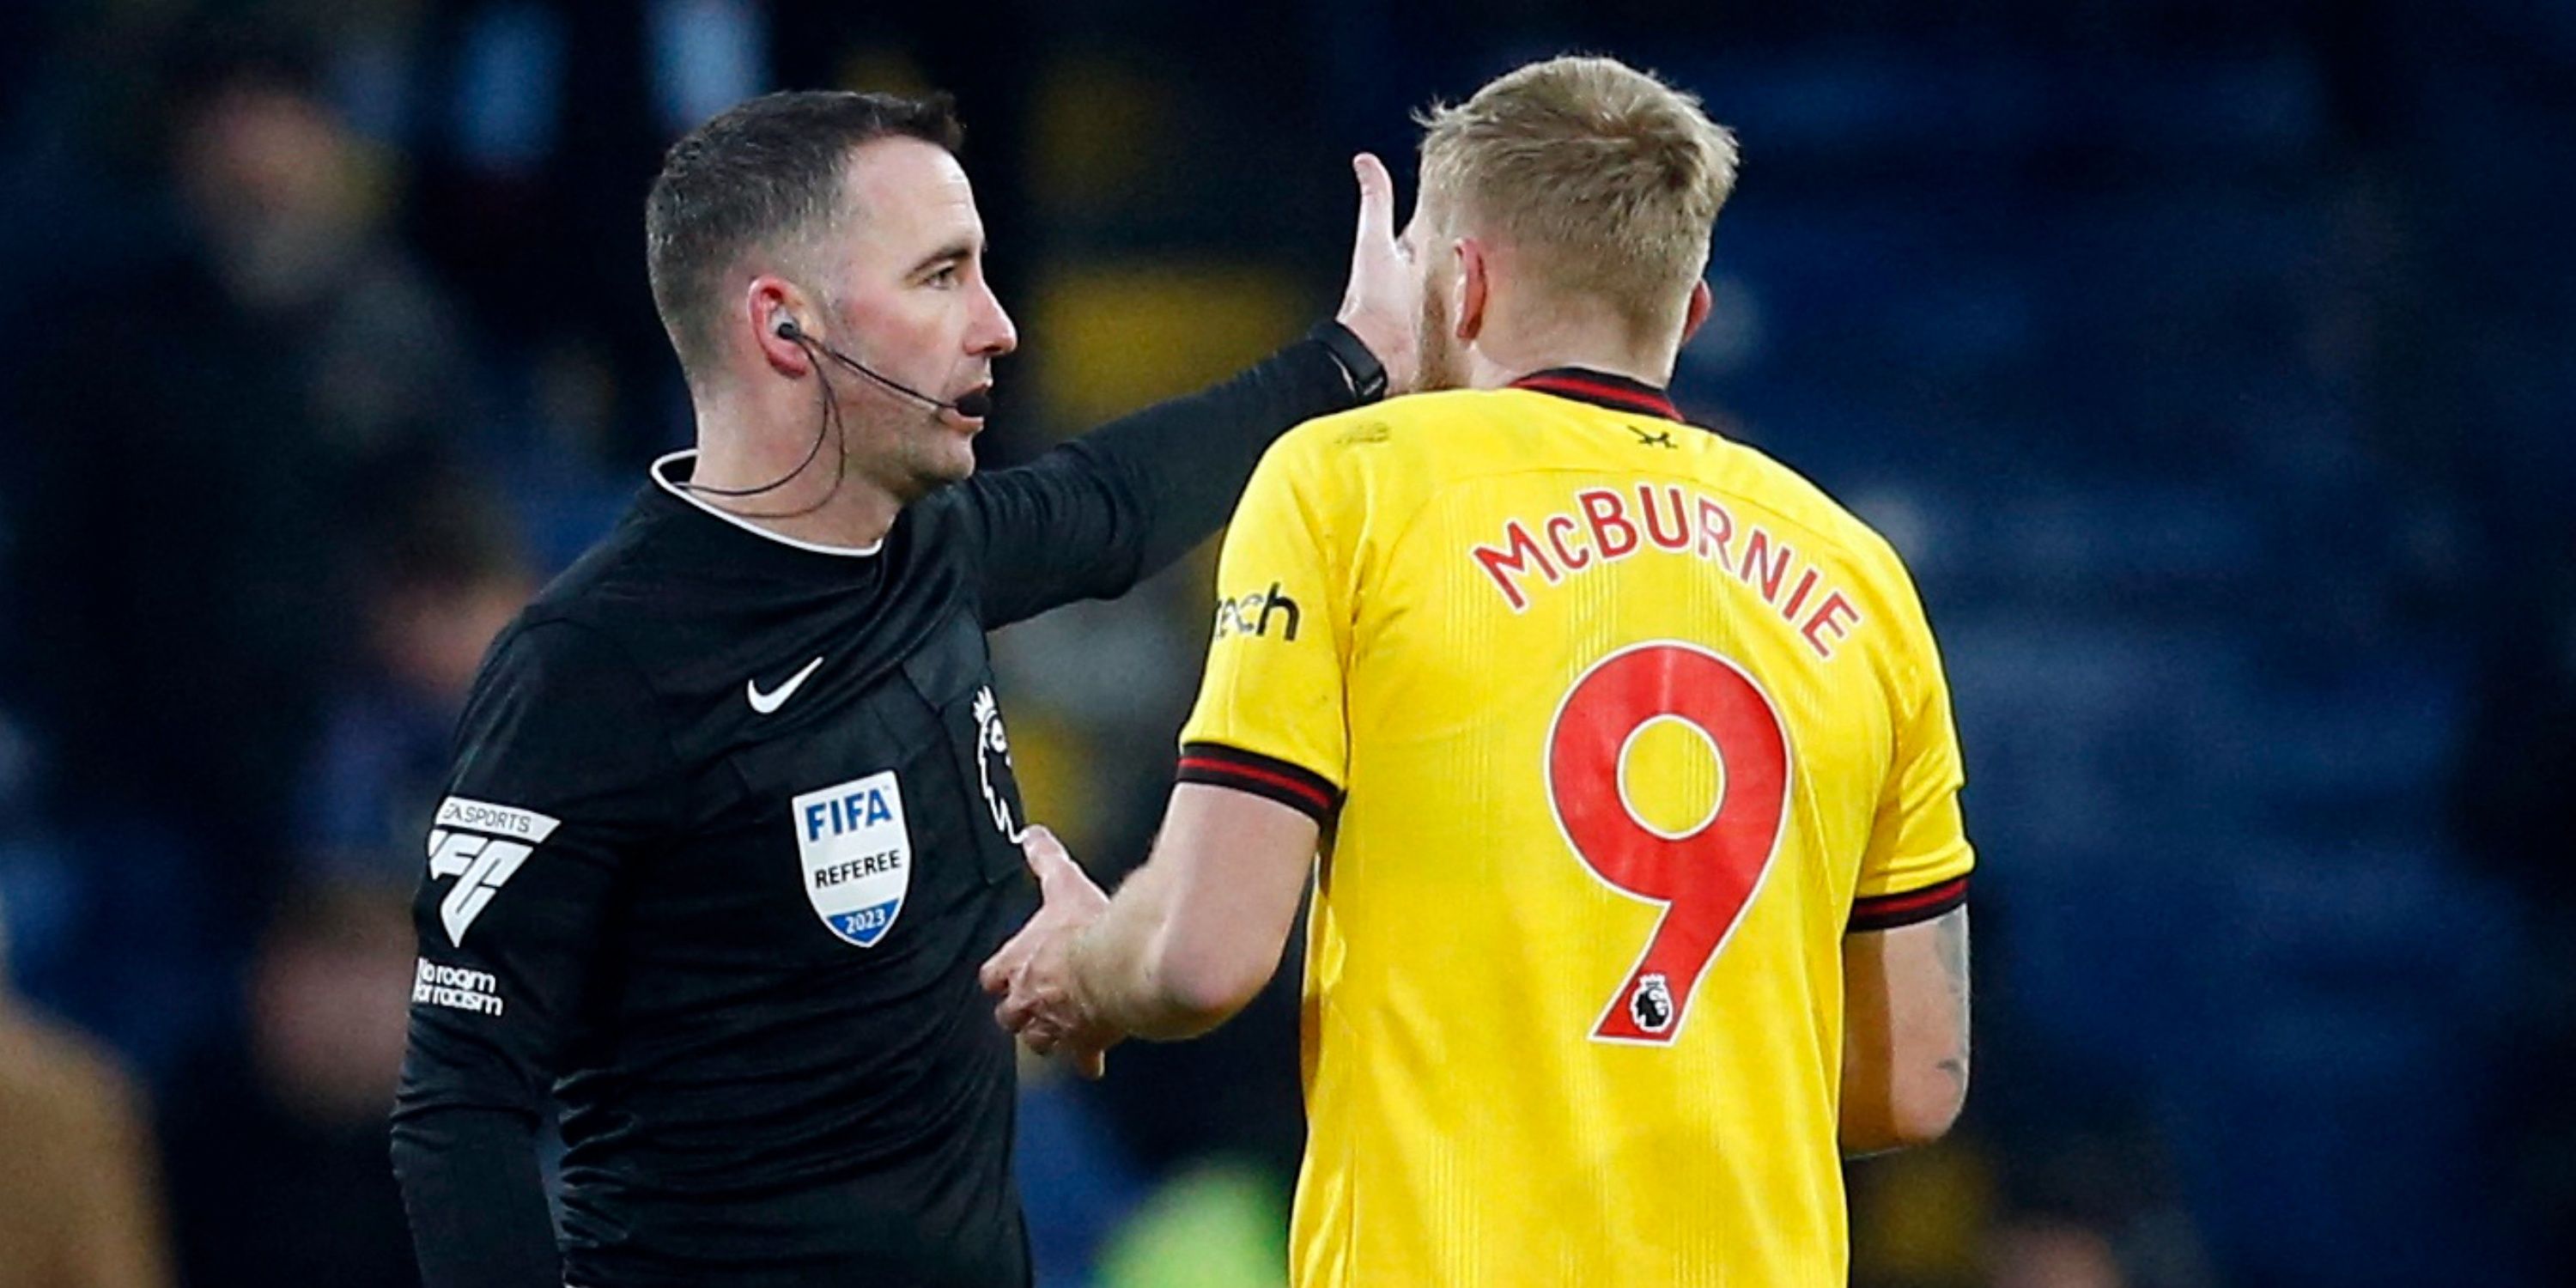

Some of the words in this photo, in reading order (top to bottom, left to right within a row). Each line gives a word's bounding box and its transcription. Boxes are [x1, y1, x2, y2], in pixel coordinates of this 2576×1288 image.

[1472, 483, 1862, 659] McBURNIE
[1213, 580, 1300, 642] ech
[464, 805, 532, 834] SPORTS
[805, 787, 894, 842] FIFA
[1543, 638, 1795, 1048] 9
[814, 848, 902, 889] REFEREE
[844, 908, 886, 935] 2023
[435, 964, 496, 994] room
[431, 985, 503, 1018] racism
